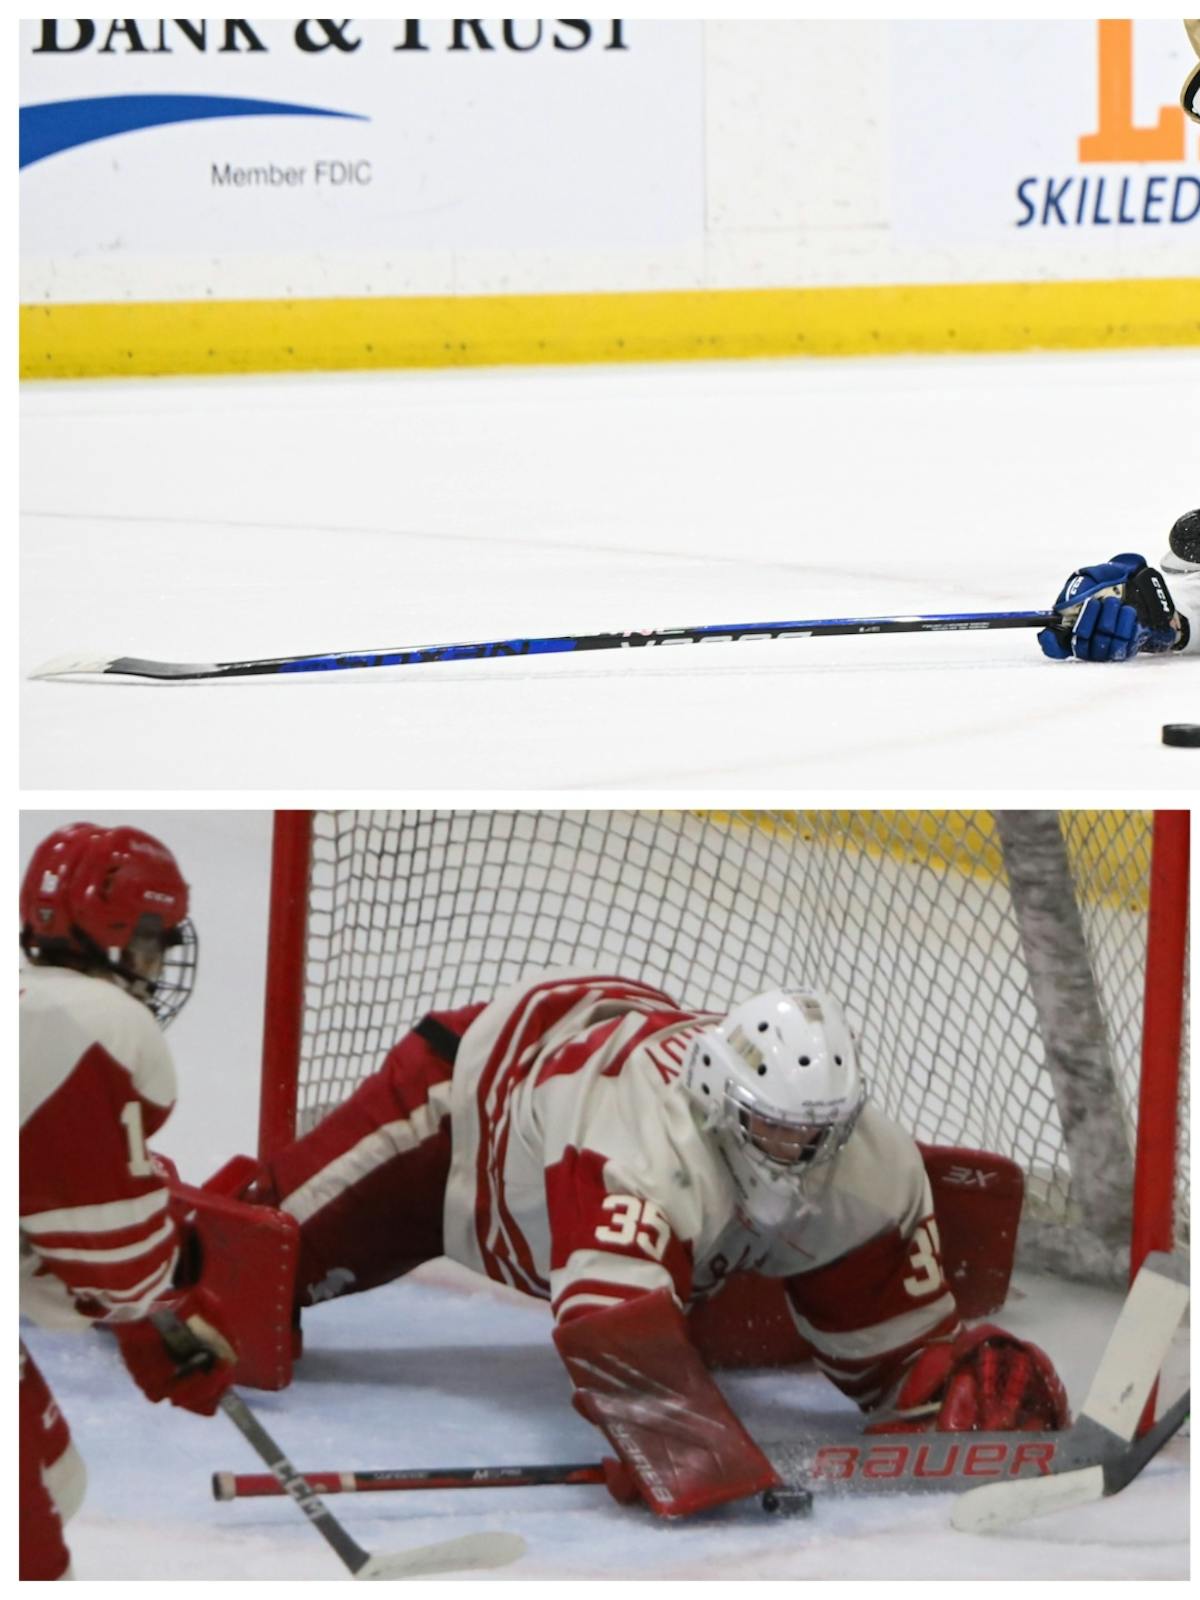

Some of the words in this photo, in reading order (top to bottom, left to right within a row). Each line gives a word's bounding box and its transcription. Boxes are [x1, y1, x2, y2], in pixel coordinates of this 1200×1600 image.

[31, 19, 268, 54] BANK
[293, 19, 362, 54] &
[393, 19, 631, 52] TRUST
[211, 163, 305, 188] Member
[314, 161, 372, 187] FDIC
[1015, 175, 1200, 227] SKILLED
[1150, 577, 1171, 613] CCM
[594, 1194, 671, 1261] 35
[811, 1440, 1057, 1479] BAUER
